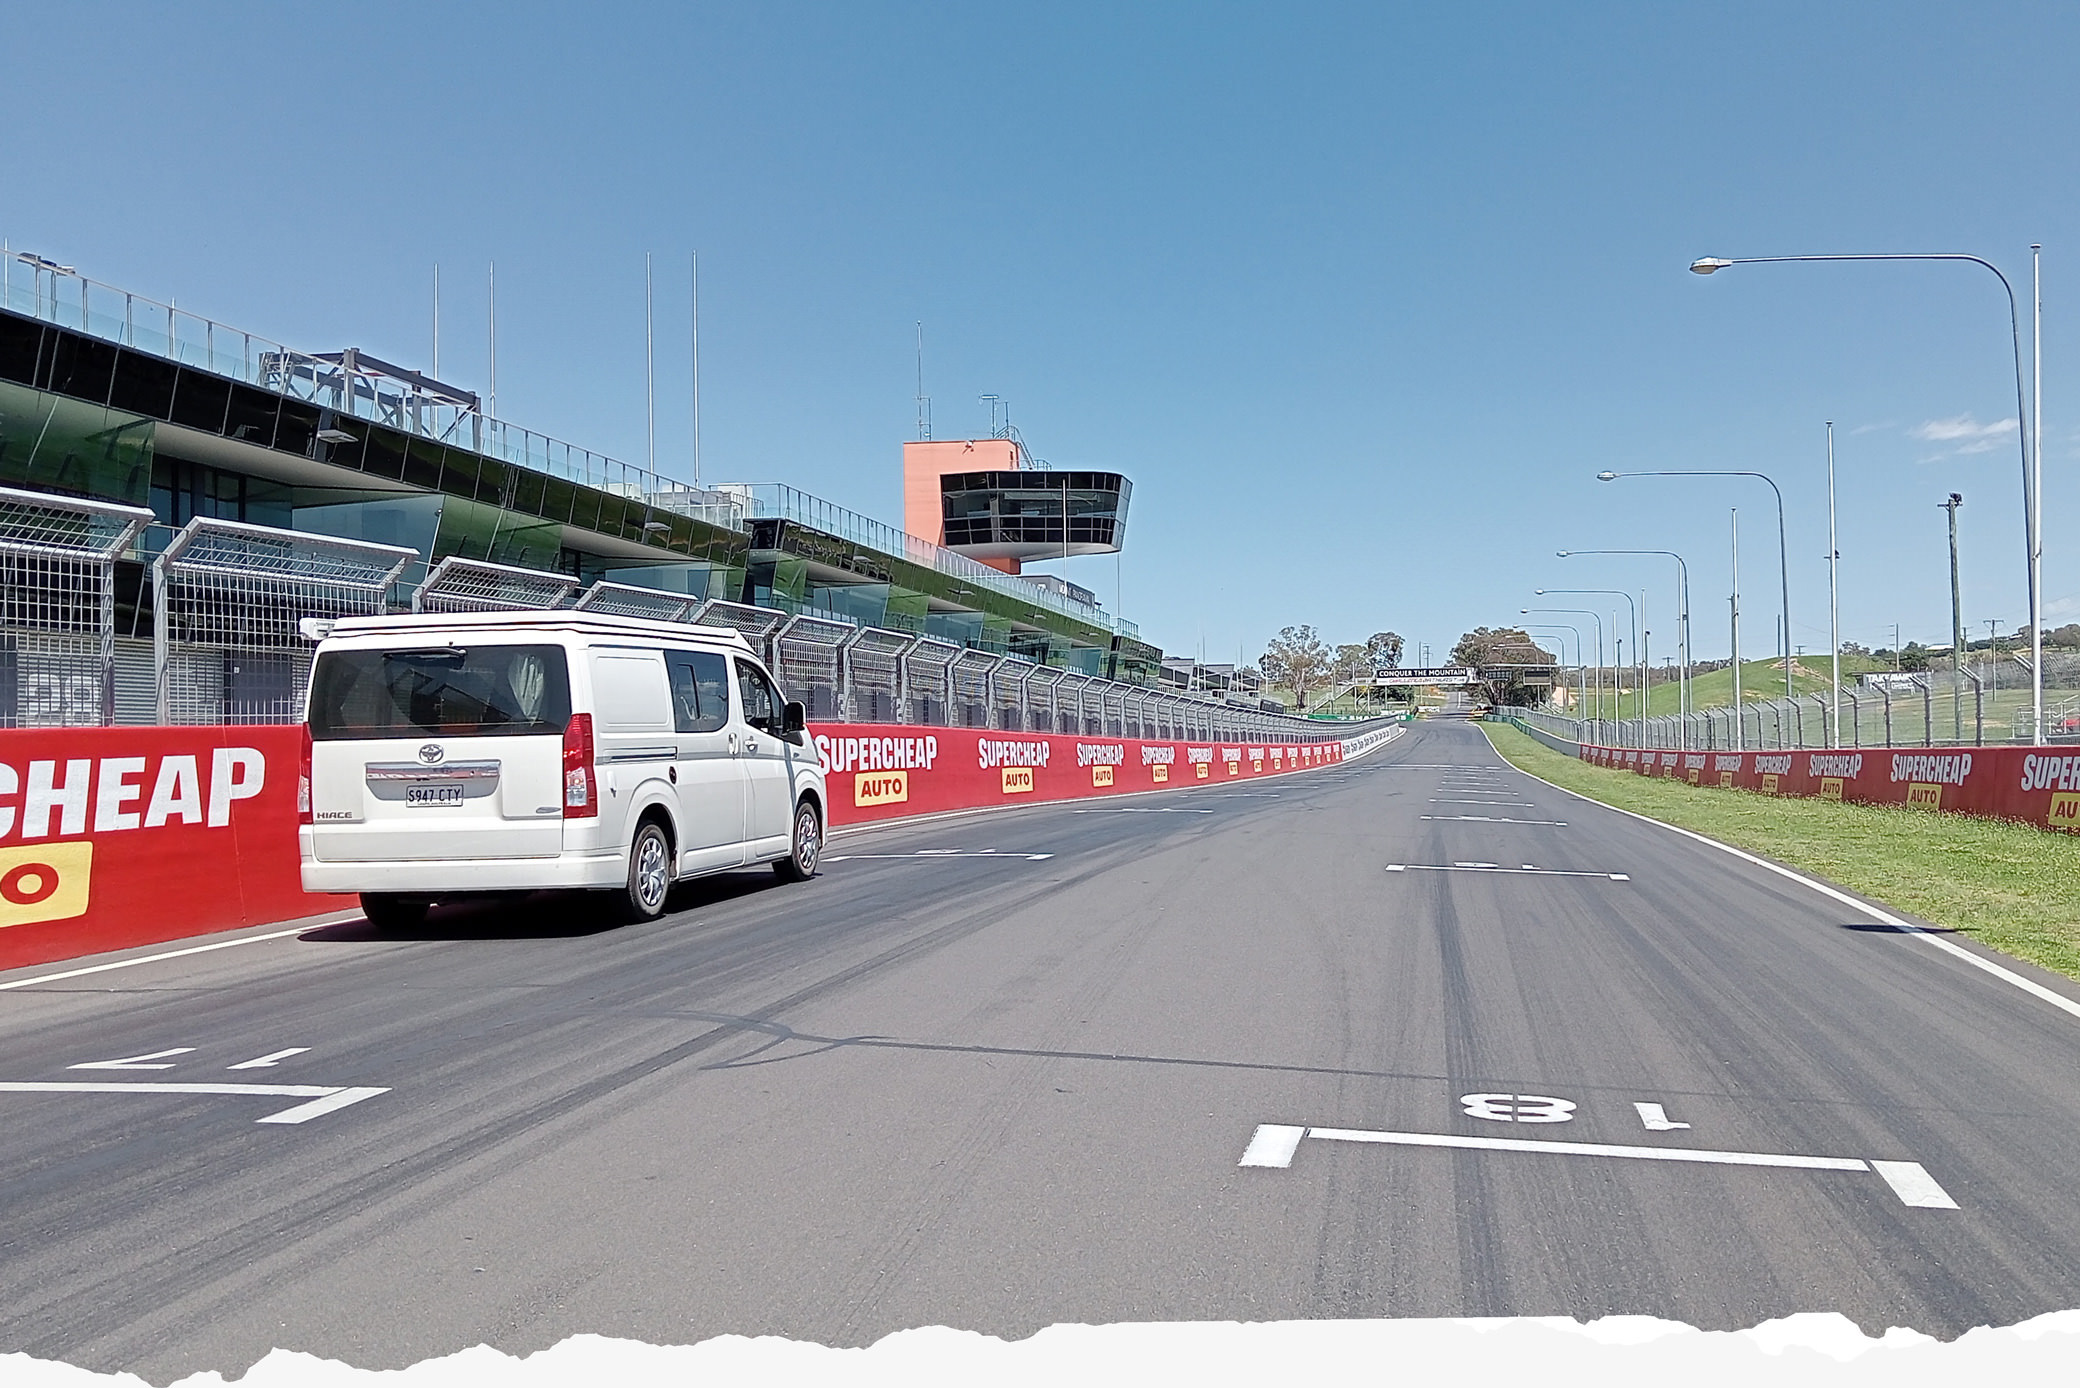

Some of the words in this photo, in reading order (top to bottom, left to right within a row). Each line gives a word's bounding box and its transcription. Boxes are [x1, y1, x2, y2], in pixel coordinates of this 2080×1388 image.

[1379, 670, 1413, 678] CONQUER
[1429, 669, 1466, 677] MOUNTAIN
[813, 735, 937, 775] SUPERCHEAP
[979, 738, 1050, 769] SUPERCHEAP
[1077, 743, 1124, 767] SUPERCHEAP
[1809, 754, 1862, 779] SUPERCHEAP
[1890, 753, 1972, 786] SUPERCHEAP
[861, 778, 902, 797] AUTO
[1005, 773, 1029, 786] AUTO
[1822, 783, 1840, 794] AUTO
[408, 789, 434, 802] S947
[439, 788, 461, 801] CTY
[1910, 789, 1937, 804] AUTO
[316, 811, 353, 819] HIACE
[1460, 1093, 1691, 1131] 18
